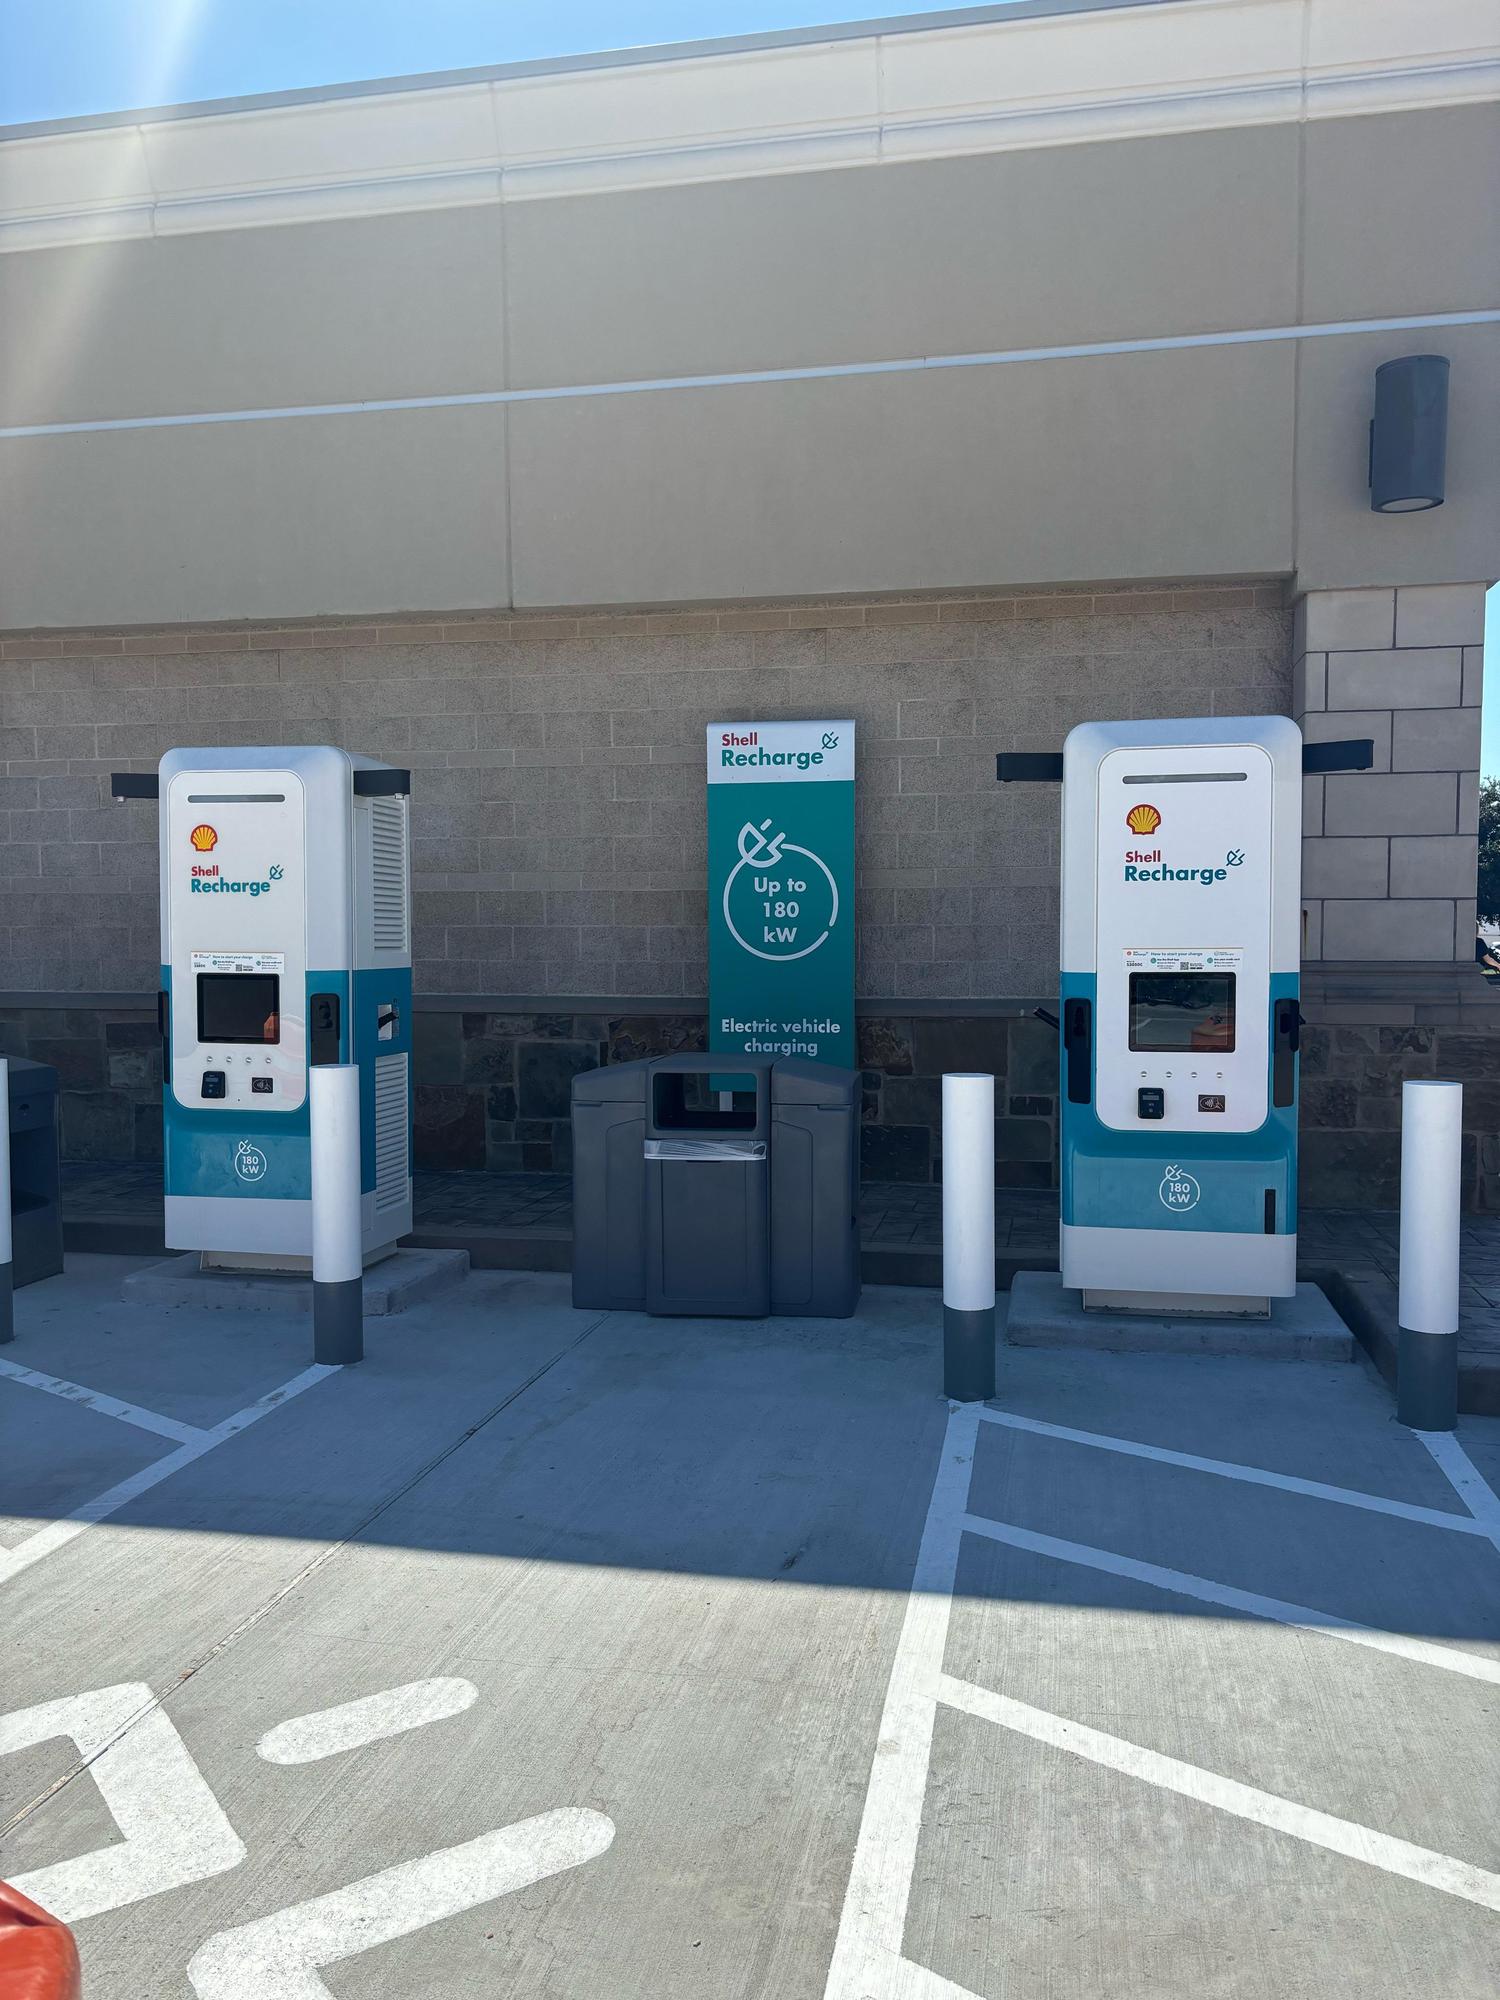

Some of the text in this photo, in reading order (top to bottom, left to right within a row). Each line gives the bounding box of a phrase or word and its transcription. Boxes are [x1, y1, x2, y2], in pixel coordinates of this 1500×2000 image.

[721, 732, 758, 747] Shell
[721, 747, 824, 770] Recharge
[1125, 850, 1161, 863] Shell
[191, 865, 219, 877] Shell
[1124, 863, 1228, 886] Recharge
[191, 877, 271, 897] Recharge
[754, 877, 807, 897] Up to
[763, 901, 800, 918] 180
[763, 926, 798, 943] kW
[721, 1017, 841, 1034] Electric vehicle
[744, 1037, 818, 1057] charging
[242, 1156, 259, 1165] 180
[242, 1164, 260, 1174] kW
[1169, 1182, 1191, 1193] 180
[1168, 1192, 1191, 1203] kW
